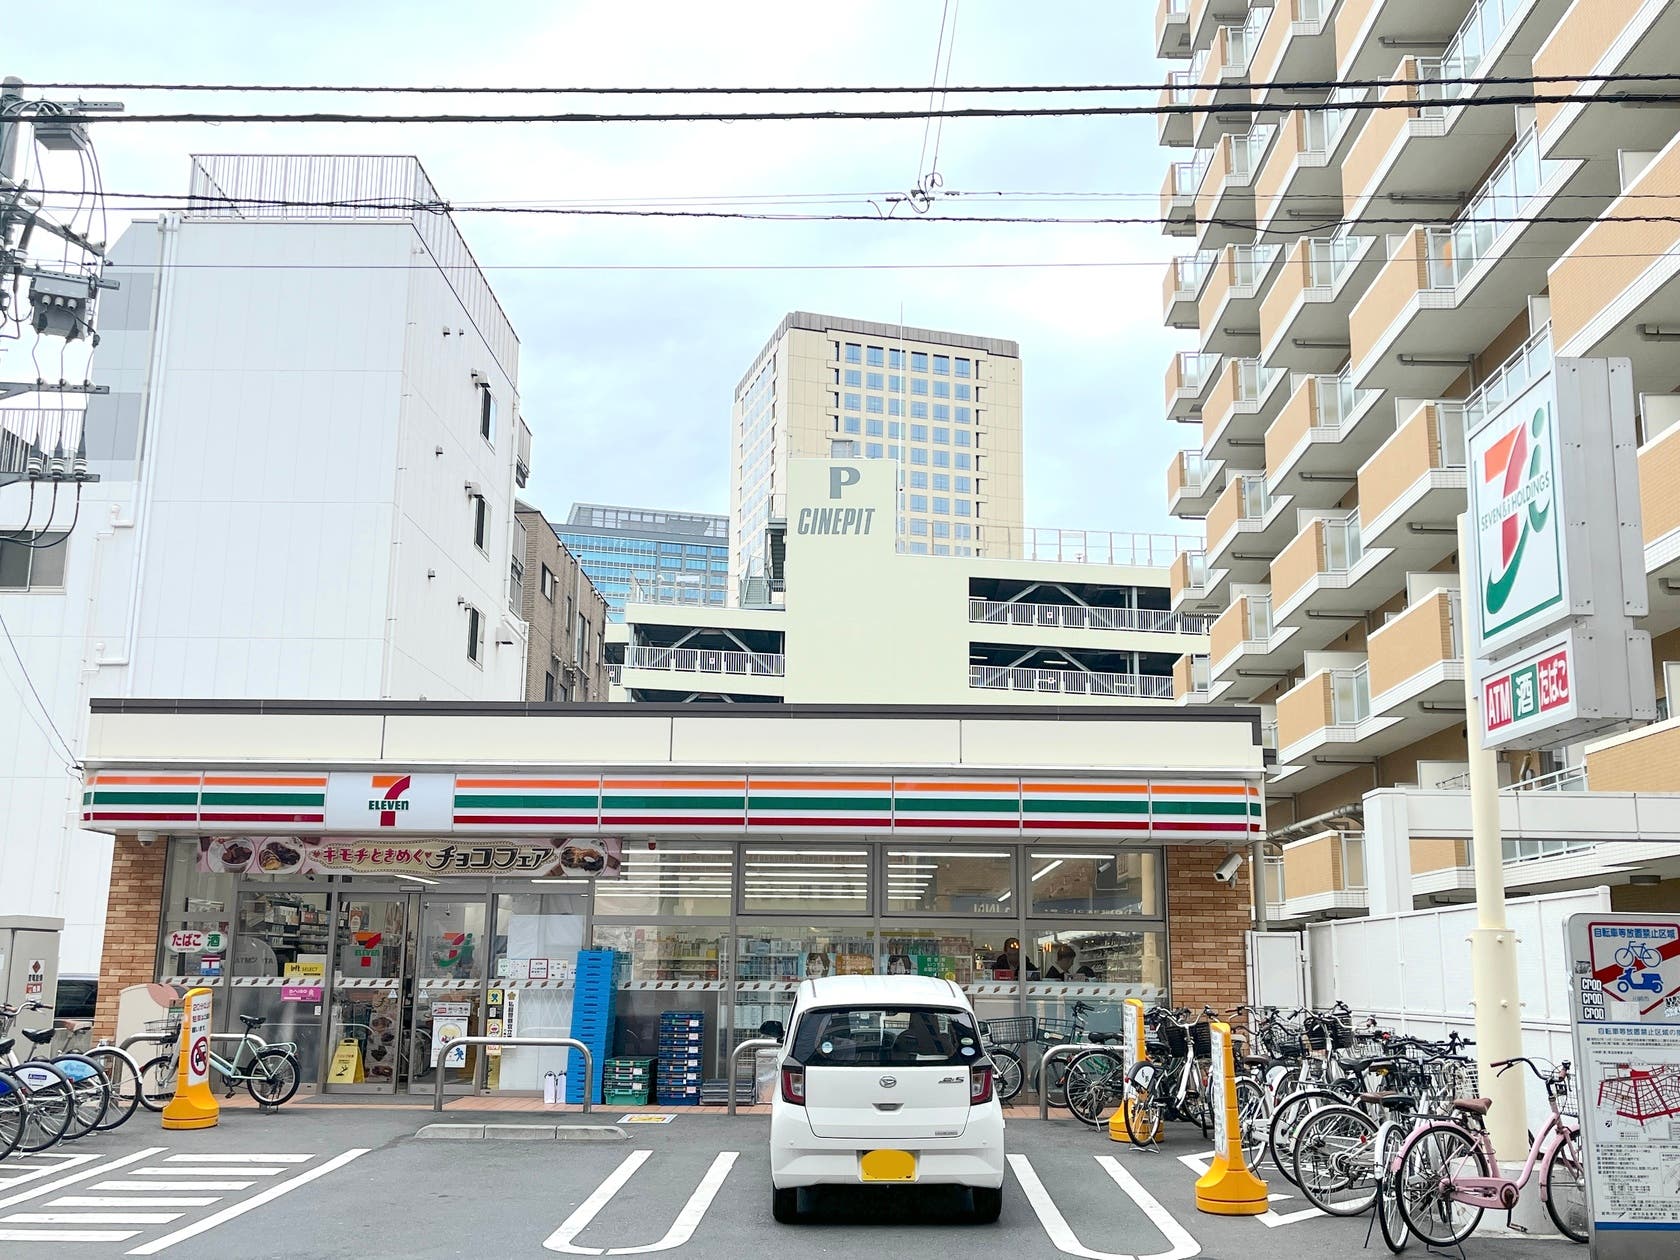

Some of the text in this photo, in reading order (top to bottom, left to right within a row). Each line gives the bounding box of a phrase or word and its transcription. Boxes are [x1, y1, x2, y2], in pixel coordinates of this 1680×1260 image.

[829, 466, 861, 499] P
[1511, 470, 1550, 511] HOLDINGS
[797, 508, 876, 535] CINEPIT
[1515, 671, 1534, 716] 酒
[1540, 658, 1568, 707] たばこ
[1488, 681, 1511, 727] ATM
[323, 845, 552, 869] キモチときめく チョコフェア
[172, 933, 202, 947] たばこ
[206, 933, 221, 947] 酒
[1594, 928, 1676, 939] 自転車等放置禁止区域
